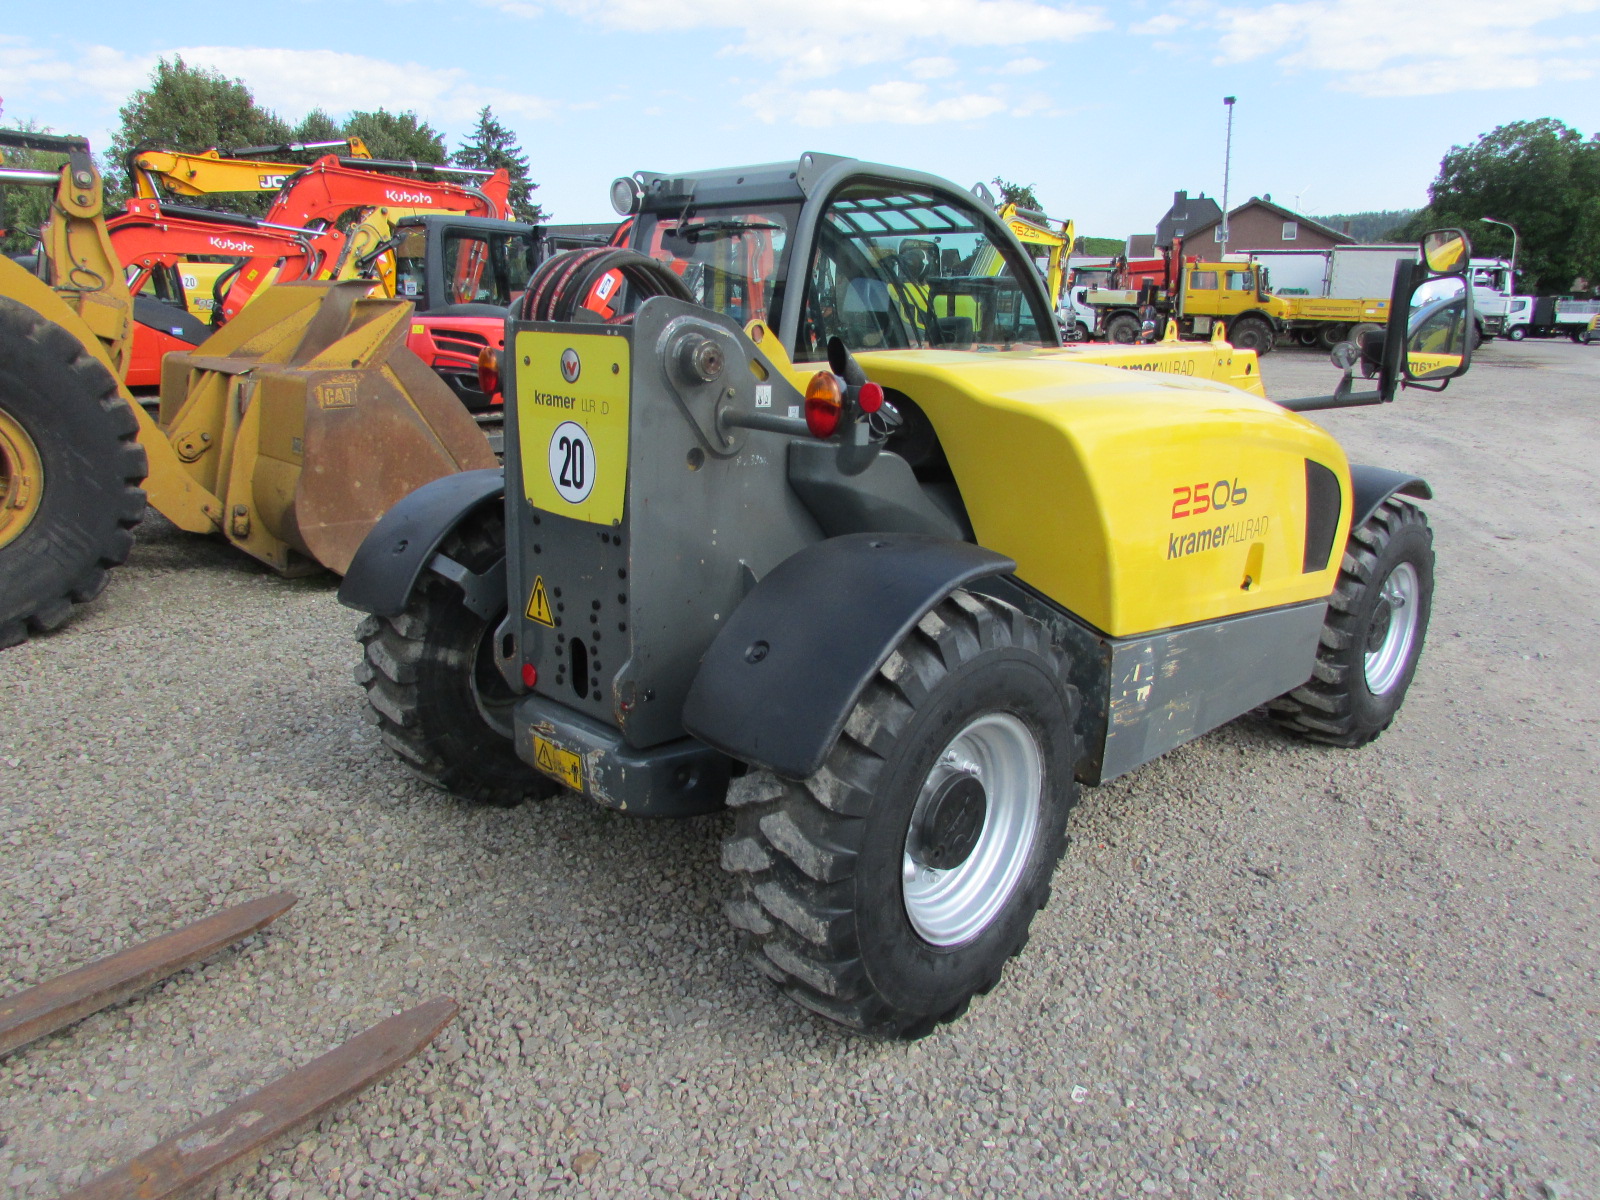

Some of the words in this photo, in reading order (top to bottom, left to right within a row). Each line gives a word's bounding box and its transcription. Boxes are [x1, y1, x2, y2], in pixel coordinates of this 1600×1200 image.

[260, 175, 289, 188] JC
[386, 190, 432, 204] Kubota
[185, 277, 195, 287] 20
[324, 387, 352, 405] CAT
[559, 436, 585, 490] 20
[1172, 477, 1248, 520] 2506
